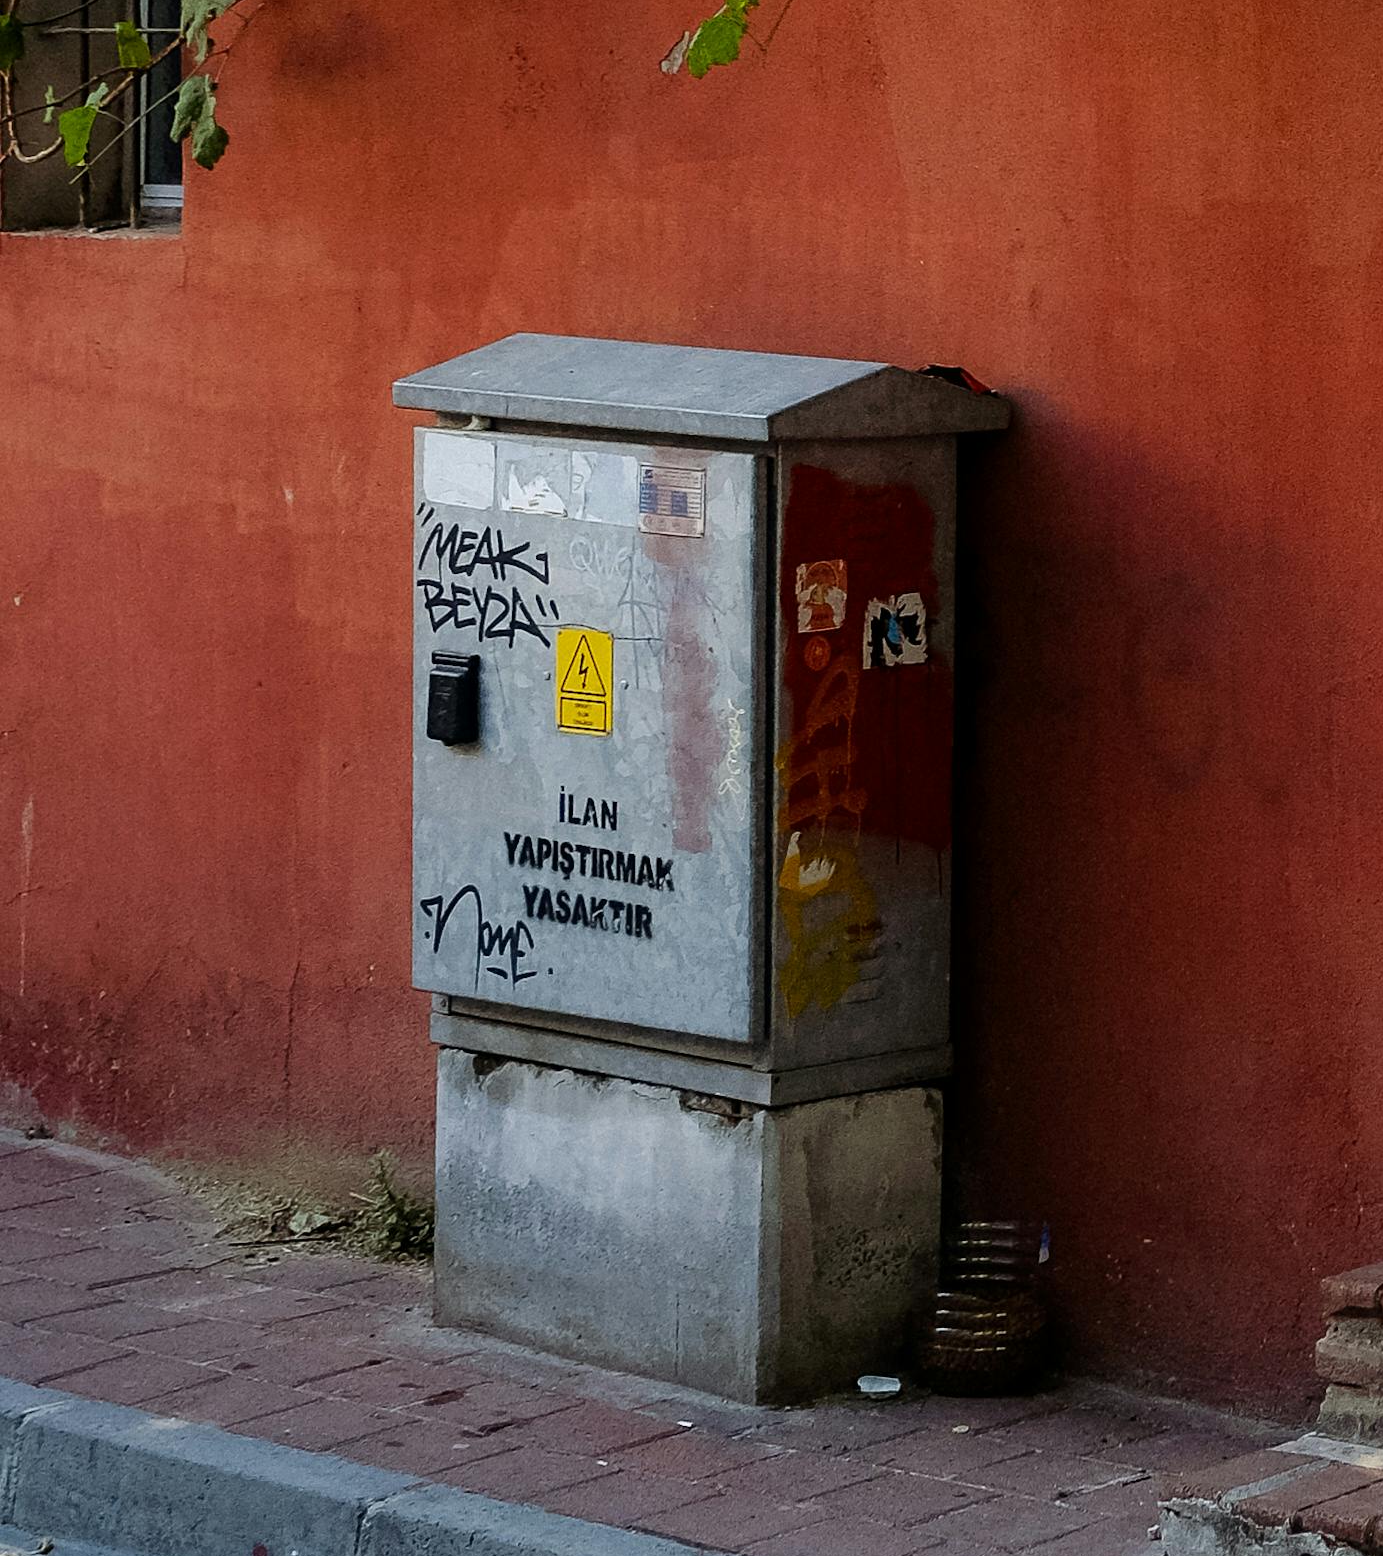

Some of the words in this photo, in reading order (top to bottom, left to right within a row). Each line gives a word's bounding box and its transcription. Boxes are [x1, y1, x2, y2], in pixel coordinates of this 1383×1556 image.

[559, 785, 618, 831] İLAN
[503, 831, 675, 891] YAPIŞTIRMAK
[522, 884, 653, 939] YASAKTIR
